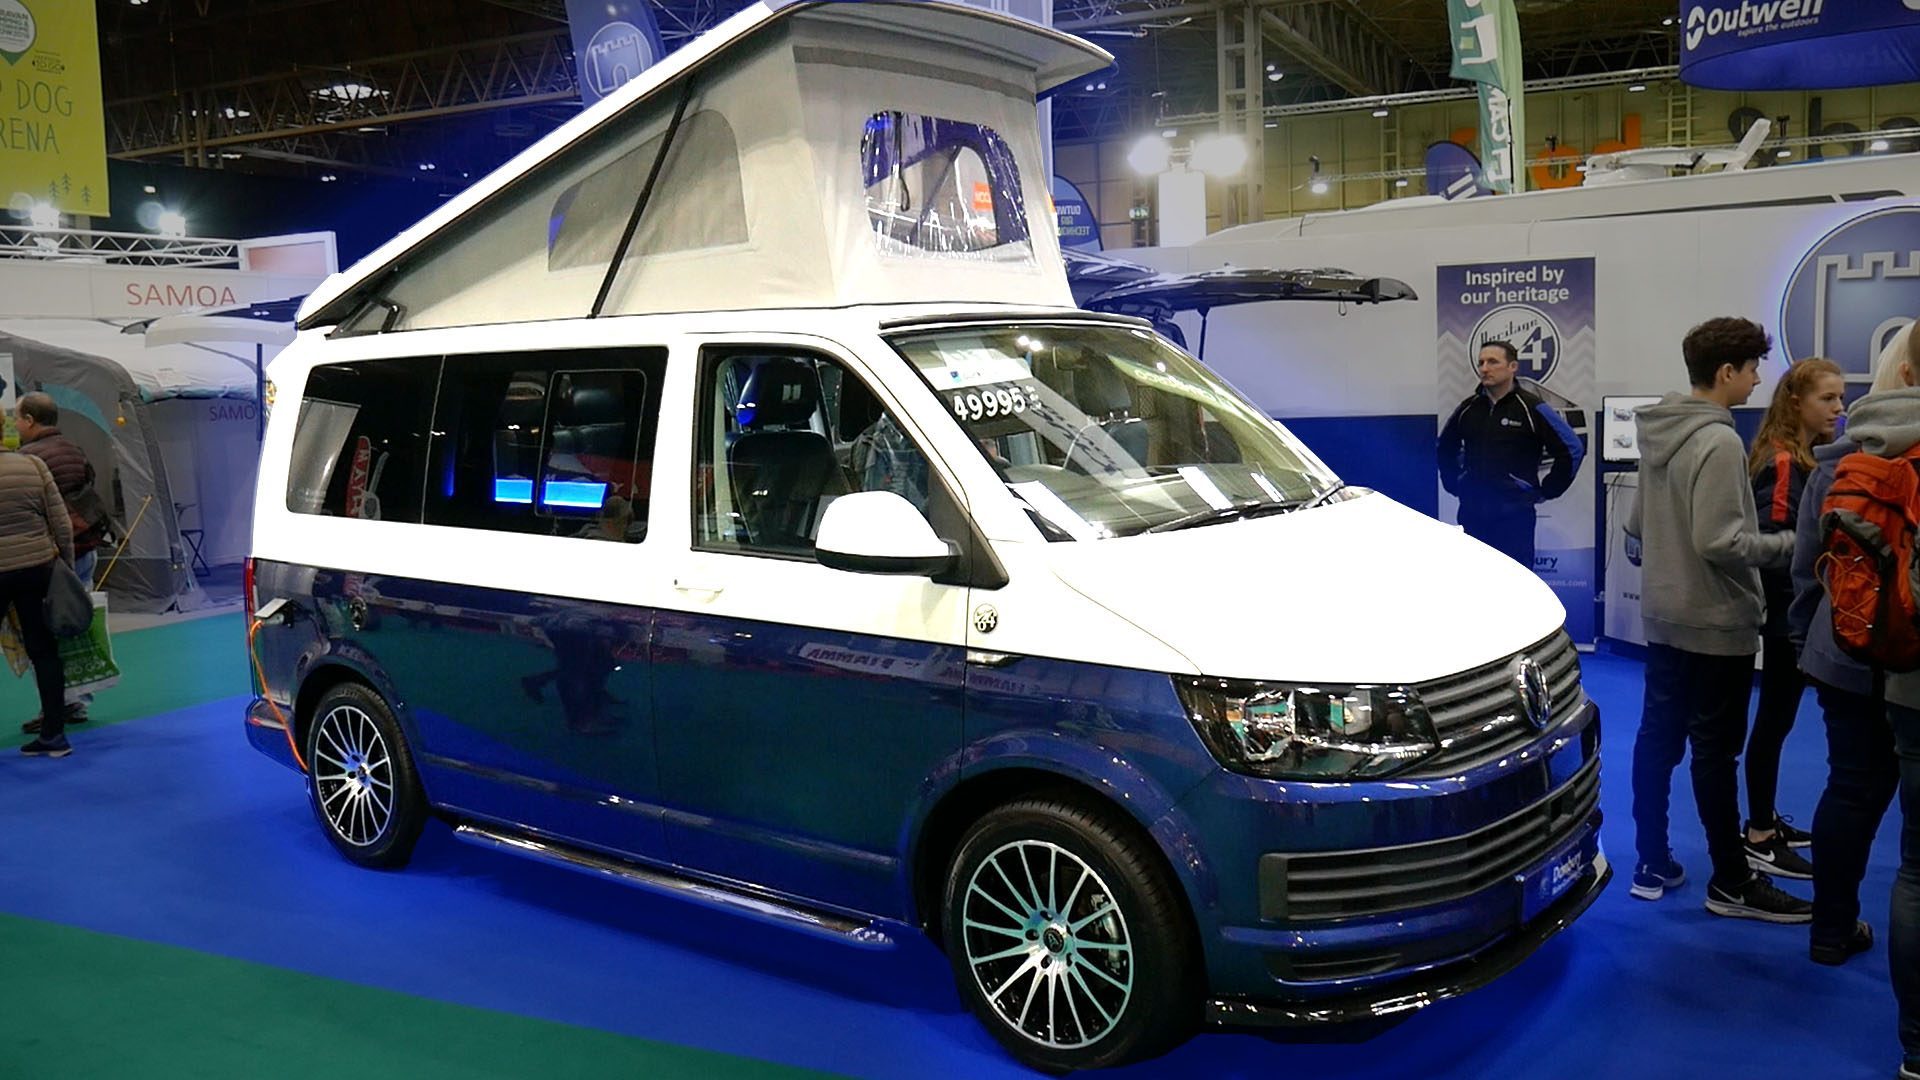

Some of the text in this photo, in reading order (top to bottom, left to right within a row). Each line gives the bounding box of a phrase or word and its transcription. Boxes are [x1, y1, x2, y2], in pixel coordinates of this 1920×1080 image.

[16, 79, 73, 117] DOG
[1465, 266, 1565, 288] Inspired by
[126, 283, 236, 307] SAMOA
[1460, 286, 1569, 304] our heritage
[1516, 326, 1548, 371] 4
[209, 404, 257, 421] SAMO
[953, 387, 1026, 421] 49995
[1534, 557, 1558, 568] ury
